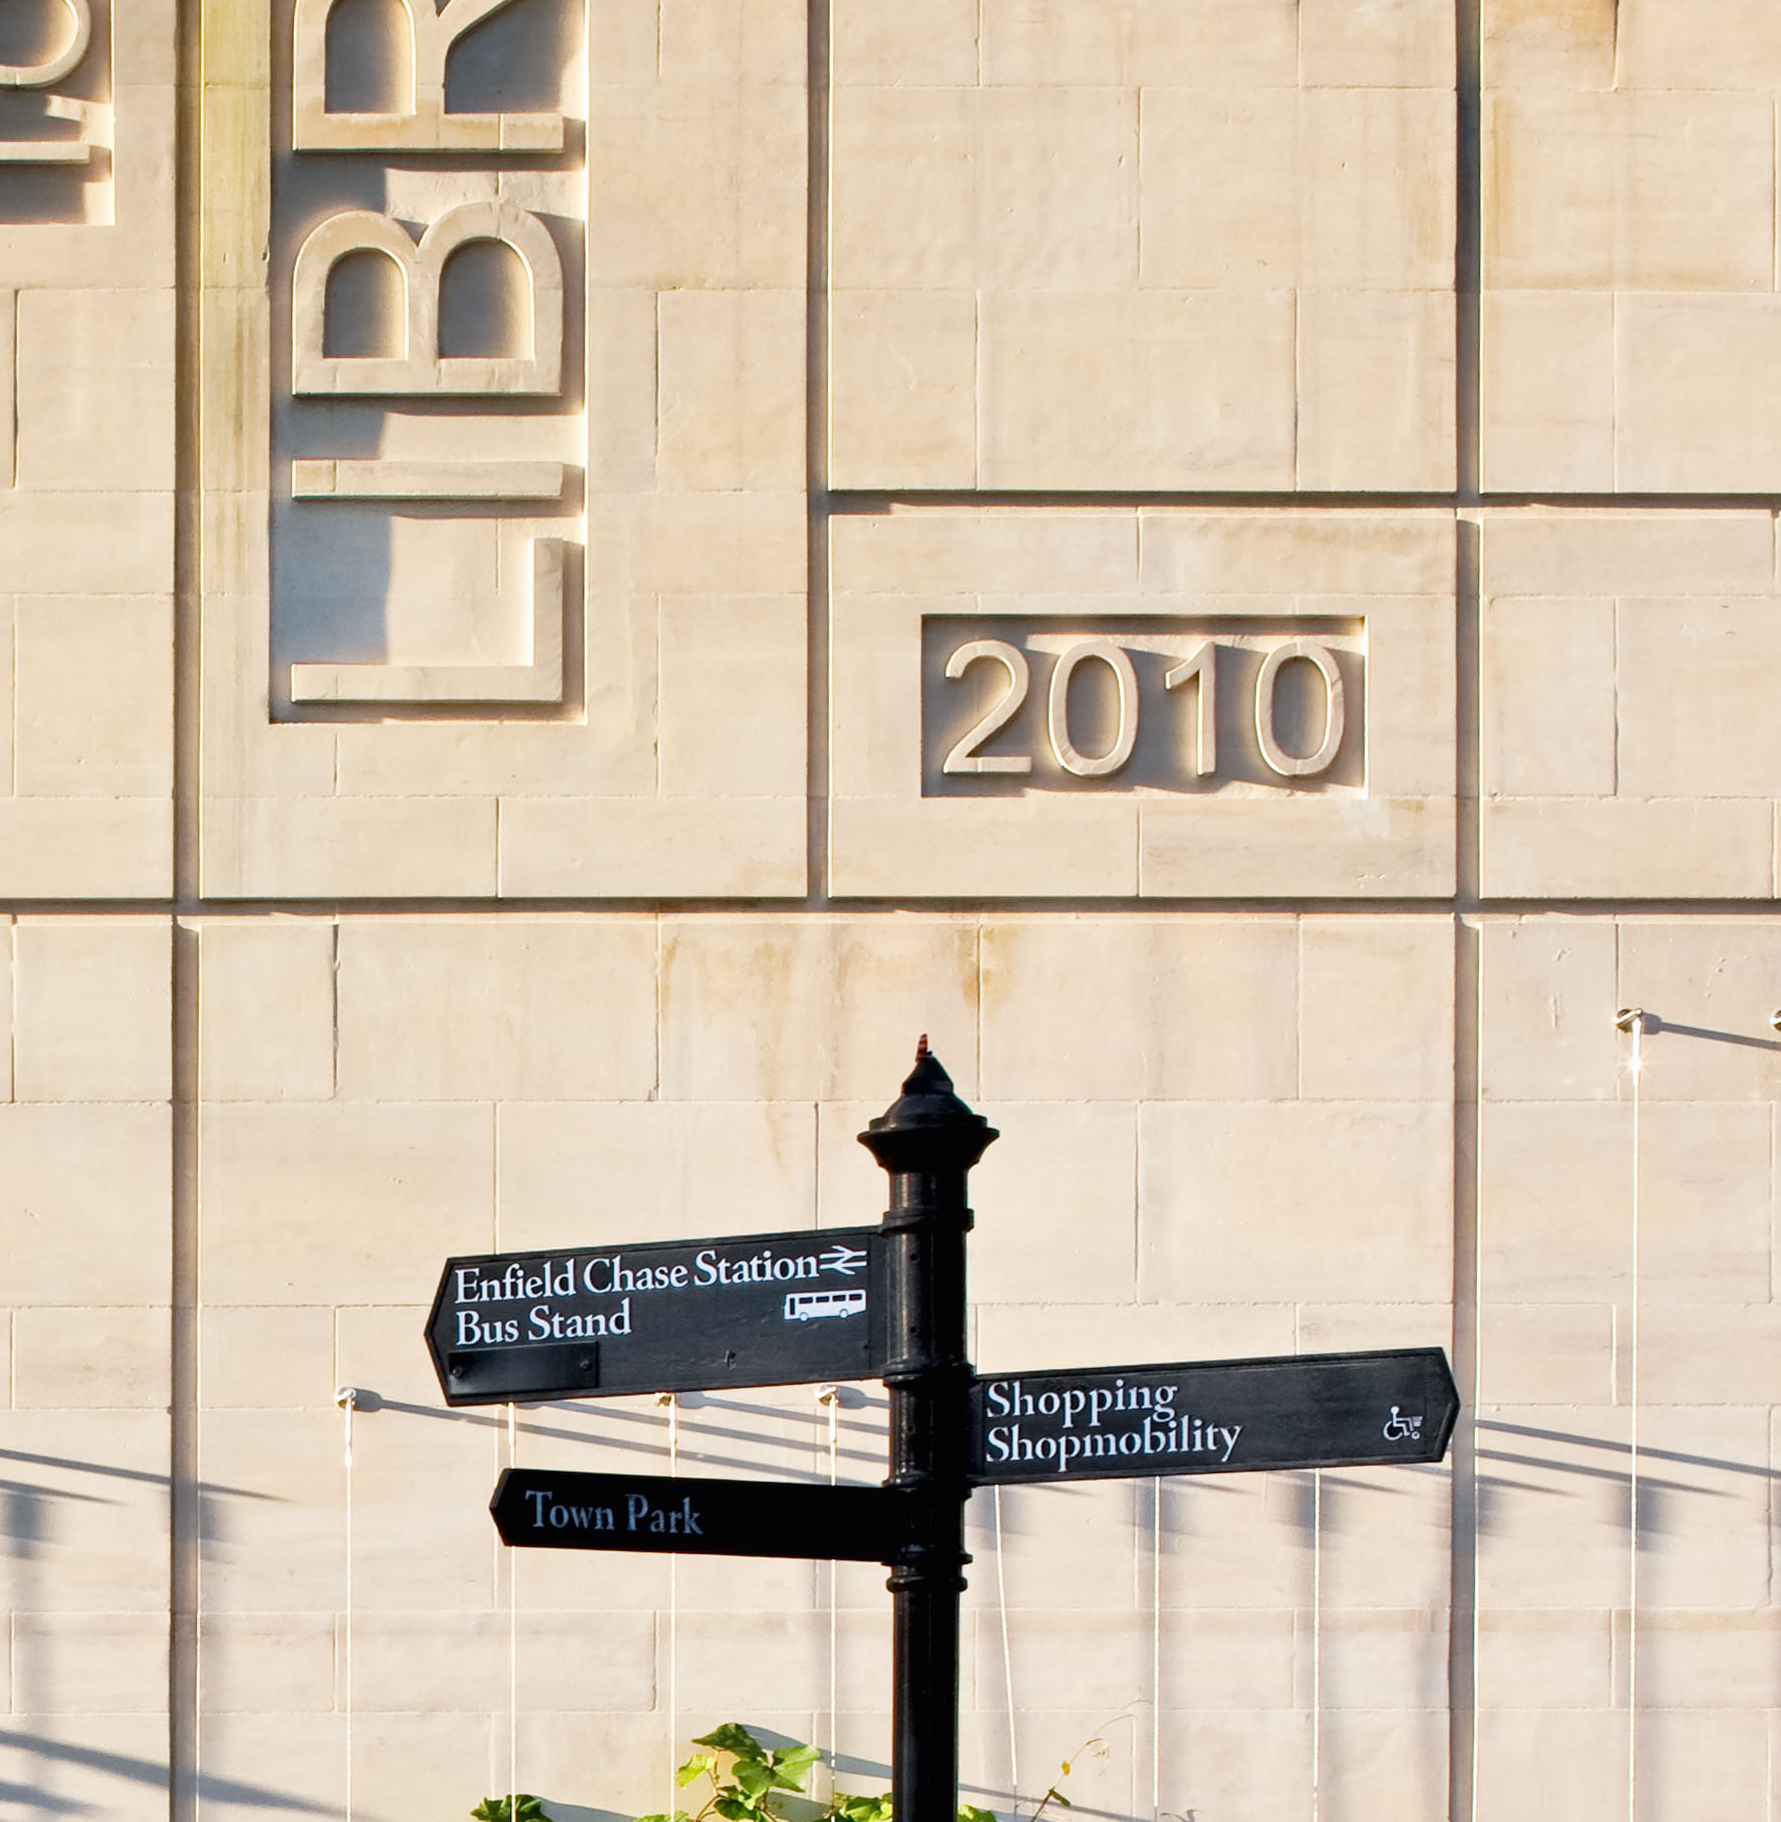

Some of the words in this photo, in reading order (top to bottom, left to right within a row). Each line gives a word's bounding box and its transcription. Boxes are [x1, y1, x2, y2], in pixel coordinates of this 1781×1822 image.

[942, 638, 1345, 777] 2010
[454, 1257, 577, 1305] Enfield
[583, 1255, 688, 1293] Chase
[693, 1249, 820, 1287] Station
[455, 1310, 519, 1346] Bus
[527, 1298, 632, 1341] Stand
[986, 1379, 1179, 1428] Shopping
[986, 1414, 1243, 1473] Shopmobility
[524, 1489, 615, 1530] Town
[625, 1493, 704, 1535] Park
